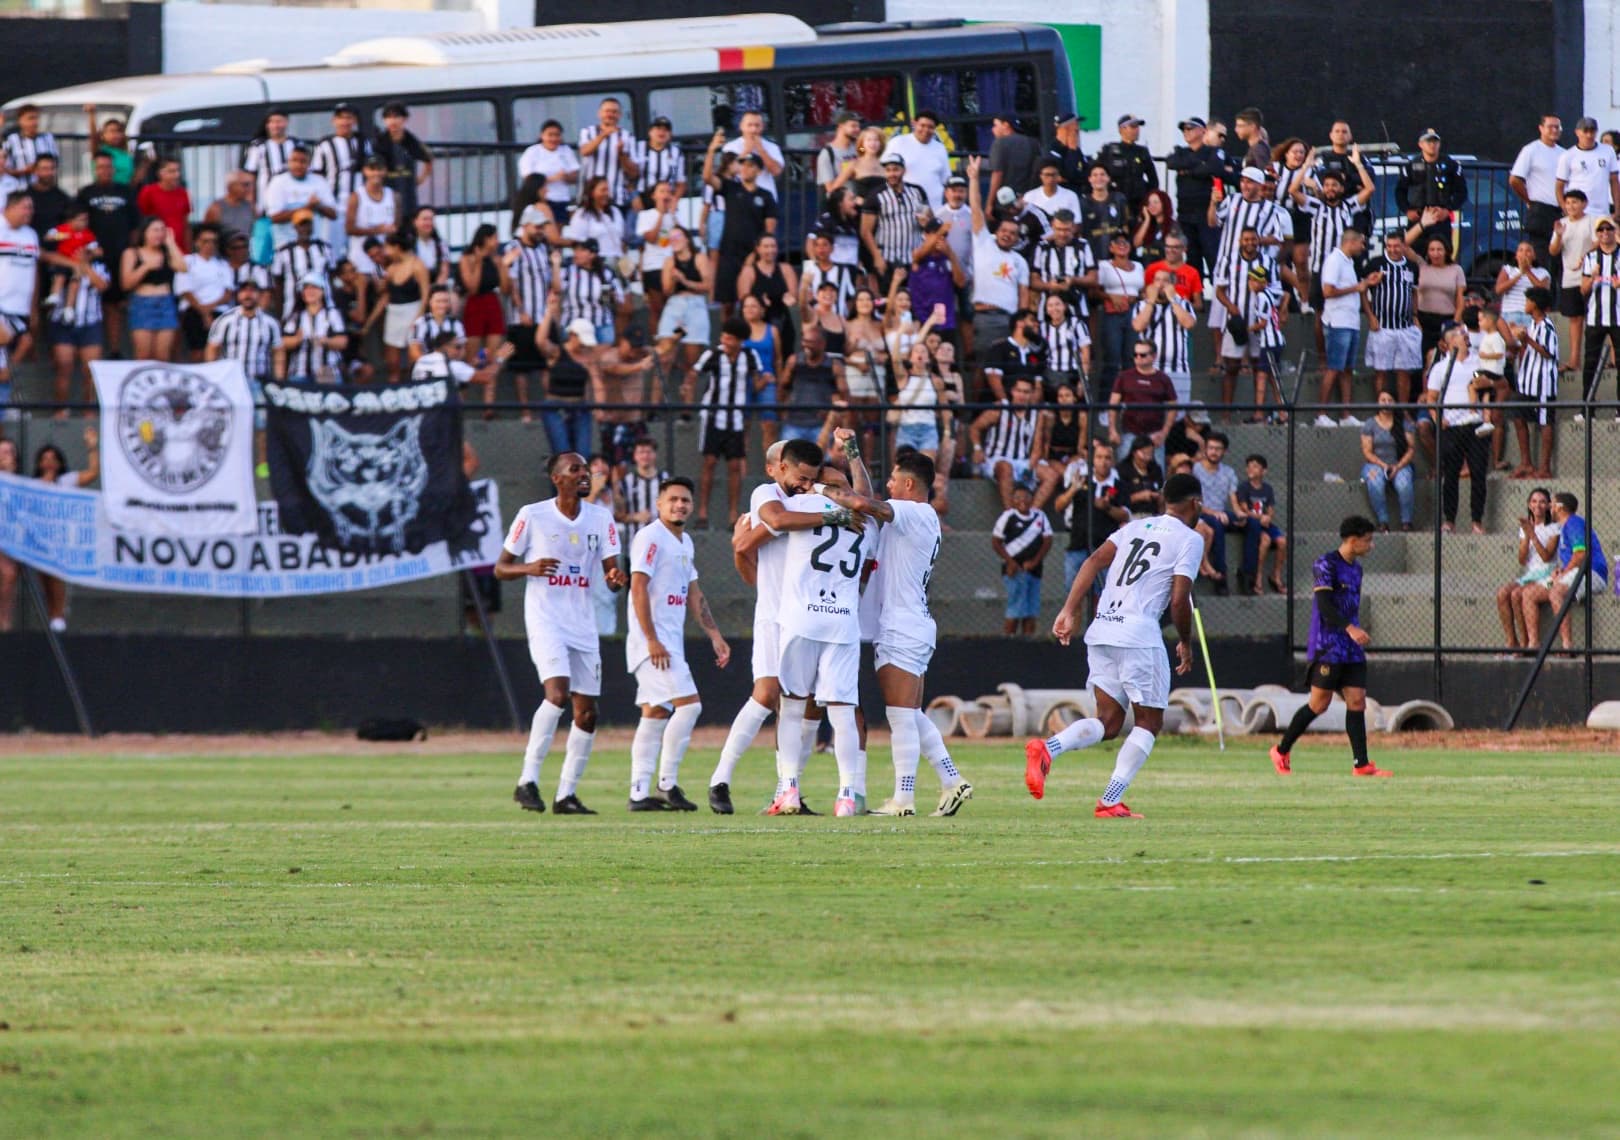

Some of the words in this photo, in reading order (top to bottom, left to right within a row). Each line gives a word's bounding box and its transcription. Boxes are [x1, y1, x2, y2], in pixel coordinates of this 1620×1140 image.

[115, 535, 237, 569] NOVO
[810, 524, 865, 579] 23
[1116, 537, 1161, 587] 16
